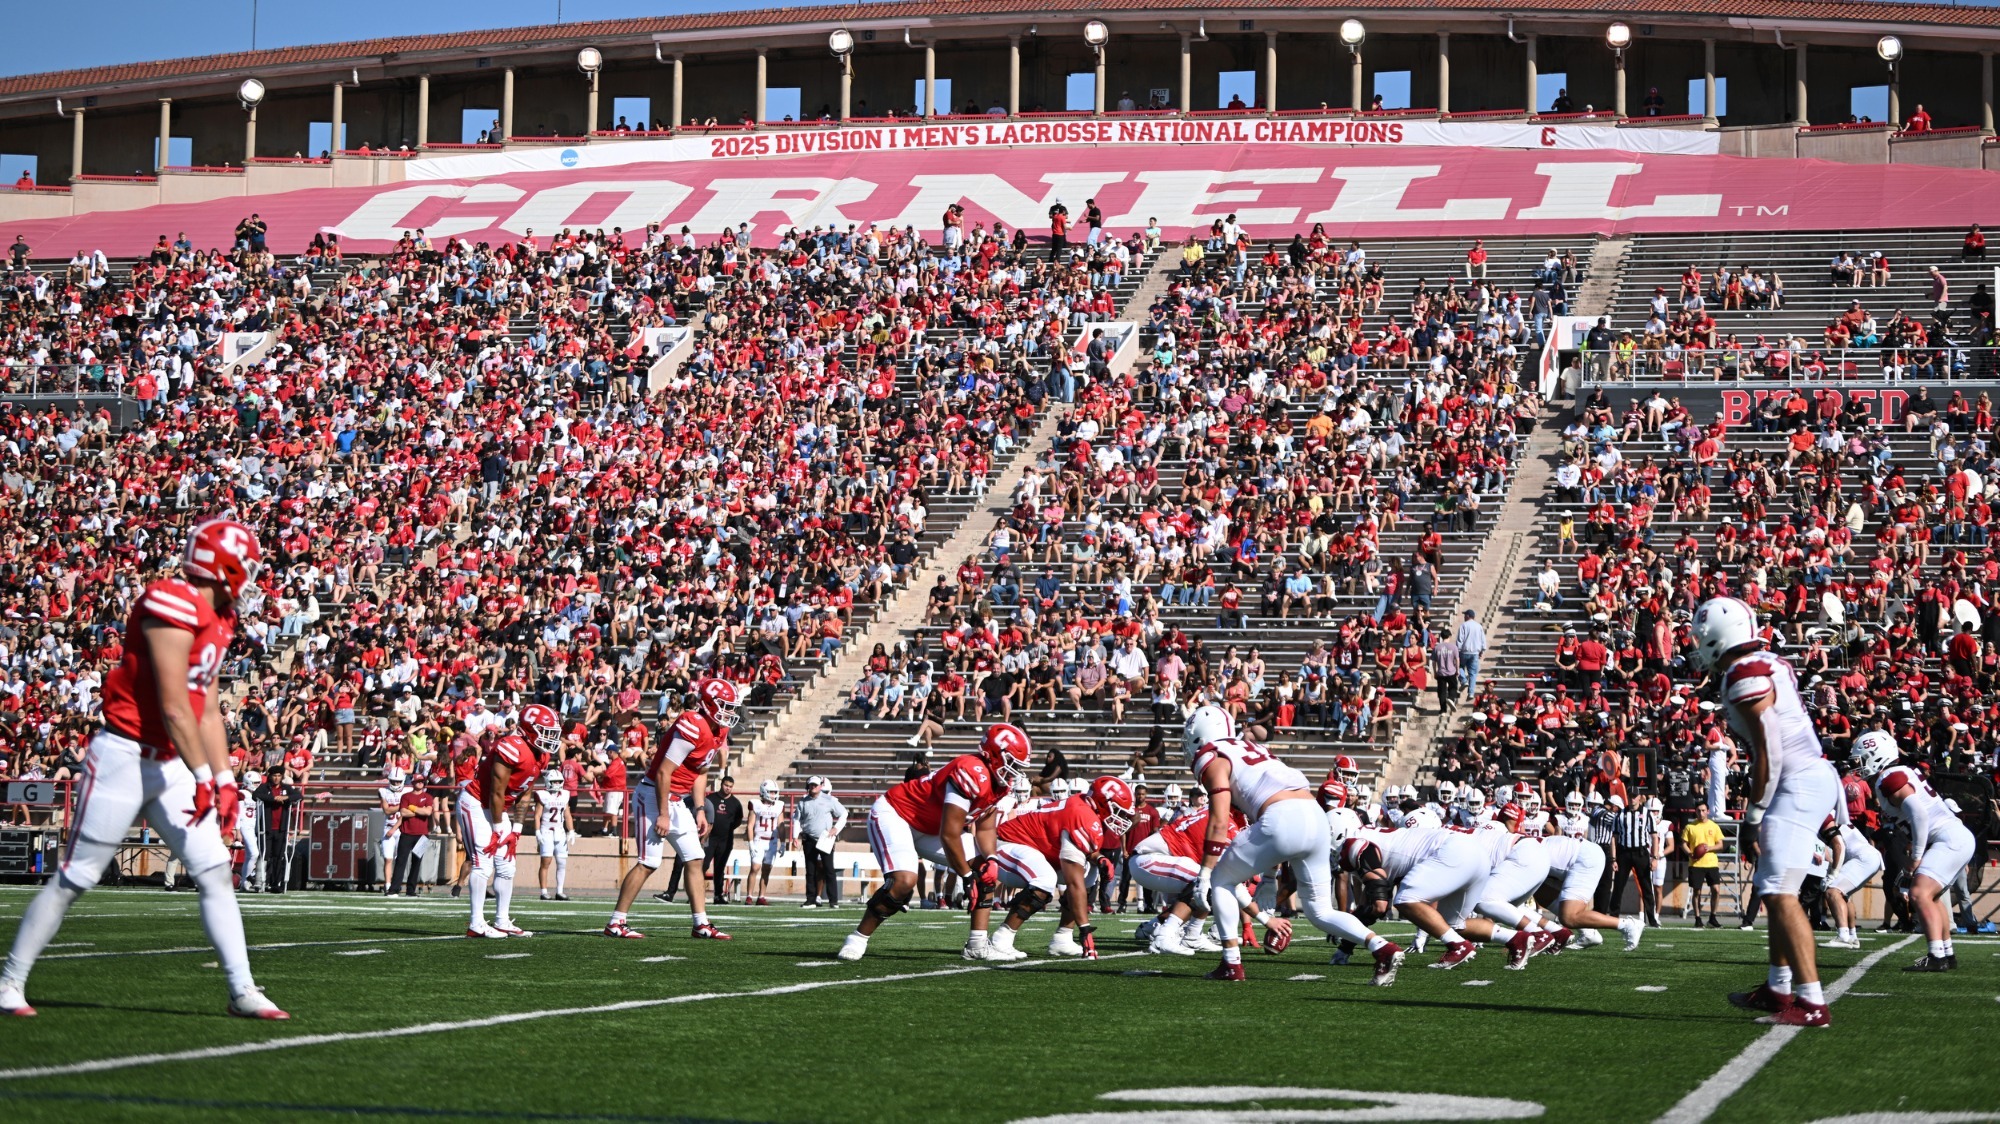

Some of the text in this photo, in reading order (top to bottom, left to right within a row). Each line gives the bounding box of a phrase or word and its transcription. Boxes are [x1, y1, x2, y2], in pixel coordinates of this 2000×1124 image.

[711, 121, 1404, 158] 2025 DIVISION I MEN'S LACROSSE NATIONAL CHAMPIONS
[1540, 127, 1556, 147] C
[334, 162, 1790, 240] CORNELL TM
[221, 526, 249, 556] C
[706, 681, 724, 696] C
[524, 707, 540, 722] C
[365, 735, 375, 746] C
[994, 729, 1018, 750] C
[1862, 738, 1876, 749] 55
[973, 765, 988, 783] 64
[1636, 753, 1648, 778] 1
[23, 783, 38, 802] G
[1100, 780, 1124, 799] C
[549, 807, 565, 823] 21
[759, 816, 775, 832] 41
[1405, 816, 1417, 829] 65
